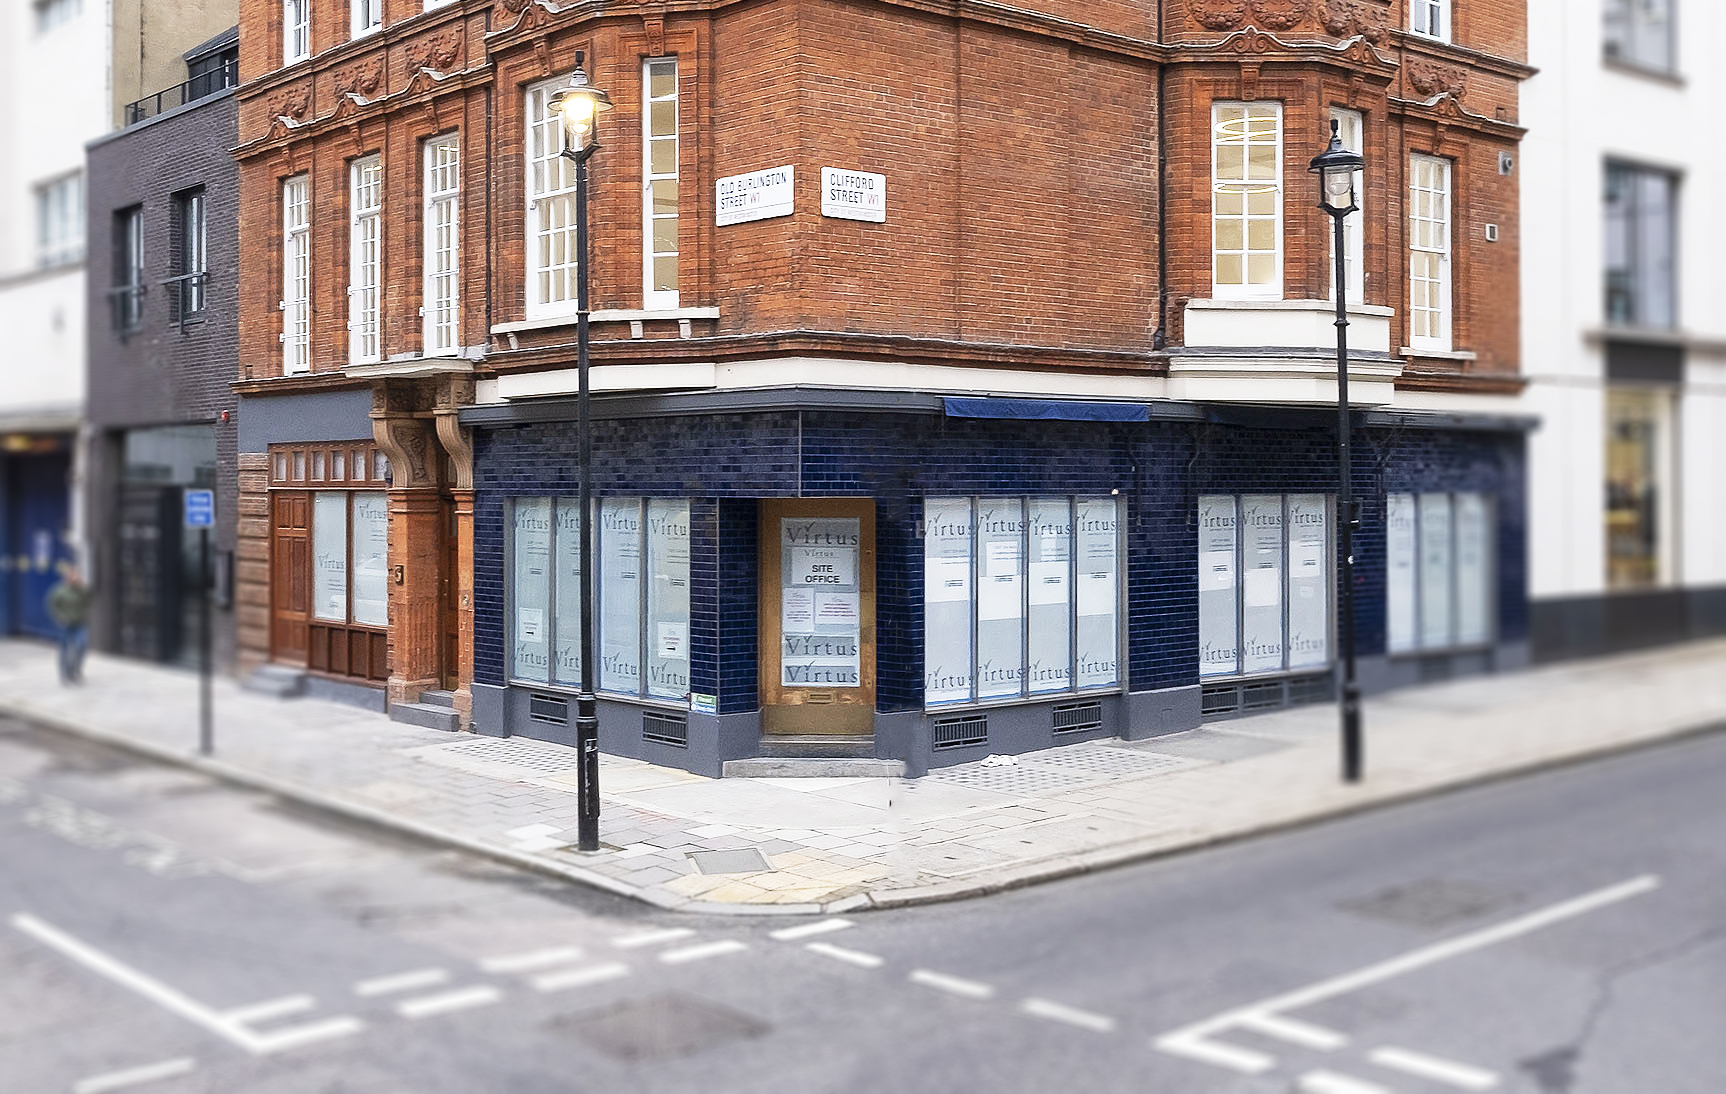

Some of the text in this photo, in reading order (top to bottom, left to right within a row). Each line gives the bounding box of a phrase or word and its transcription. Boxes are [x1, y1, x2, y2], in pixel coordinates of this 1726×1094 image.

[720, 171, 787, 195] OLD BURLINGTON
[830, 173, 874, 190] CLIFFORD
[720, 192, 761, 210] STREET W1
[830, 188, 879, 206] STREET W1
[603, 507, 640, 531] Virtu
[786, 521, 858, 546] Virtus
[812, 564, 833, 573] SITE
[805, 575, 840, 584] OFFICE
[785, 635, 857, 656] Virtus
[603, 652, 638, 676] Virtu
[785, 660, 858, 683] Virtus
